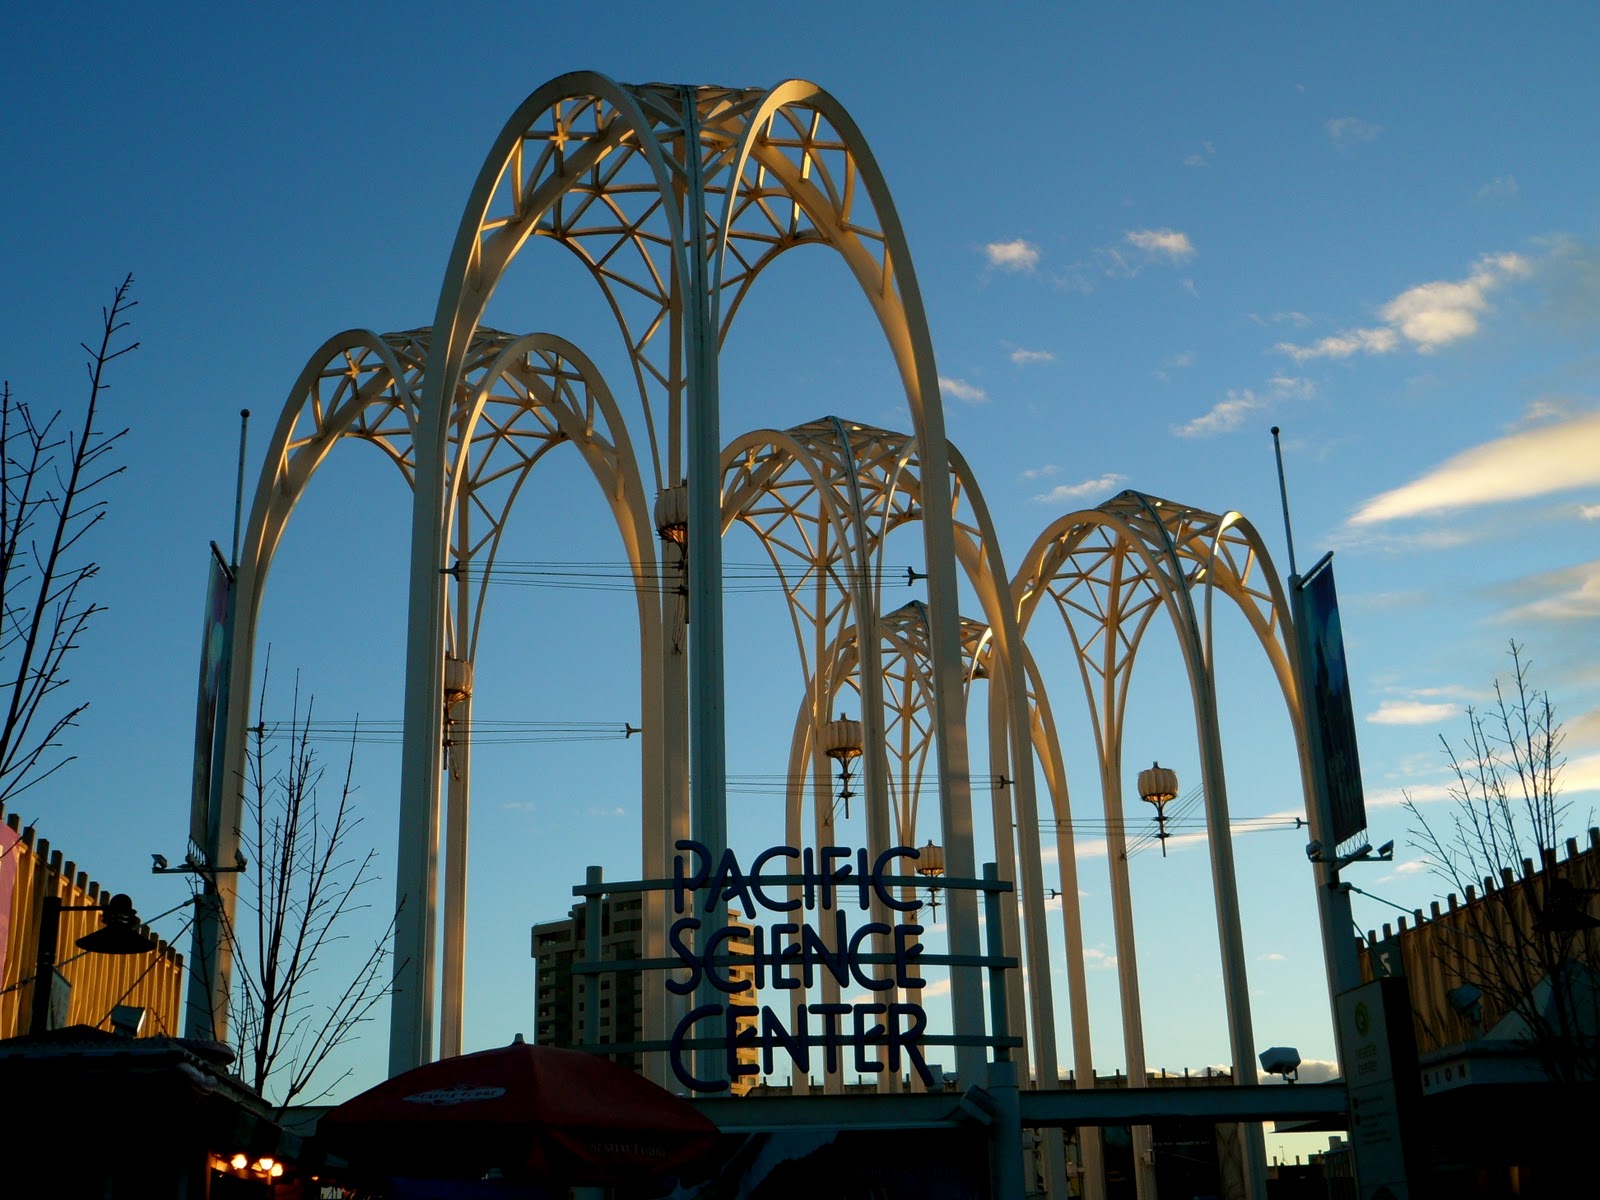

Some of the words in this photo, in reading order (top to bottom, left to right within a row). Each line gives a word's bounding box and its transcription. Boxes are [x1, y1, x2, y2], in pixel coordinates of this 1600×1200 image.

[673, 840, 924, 920] PACIFIC
[665, 909, 927, 995] SCIENCE
[669, 1003, 935, 1092] CENTER
